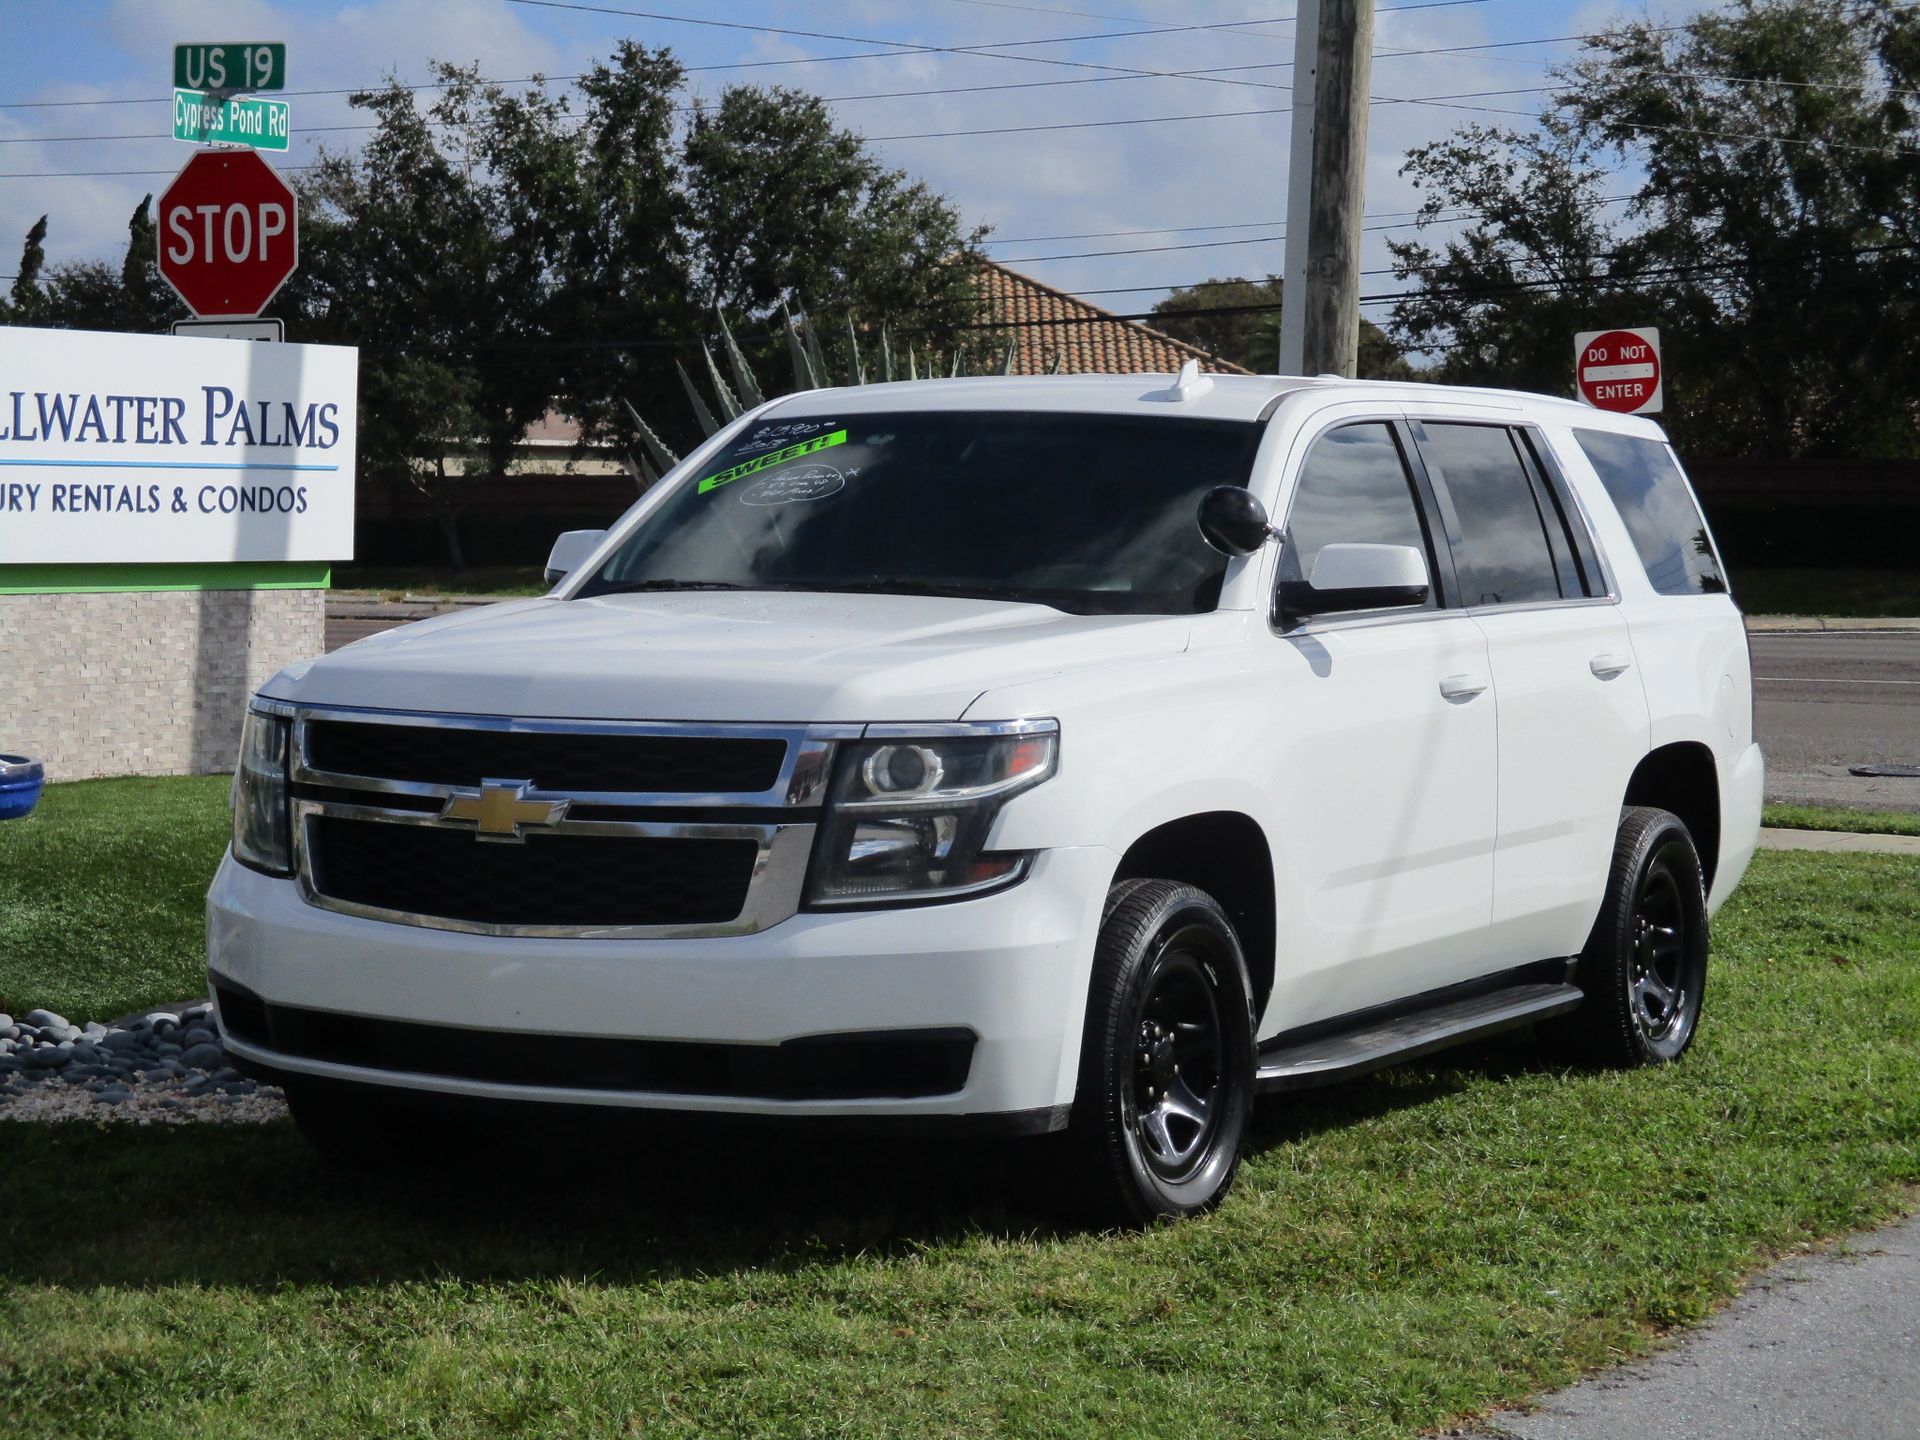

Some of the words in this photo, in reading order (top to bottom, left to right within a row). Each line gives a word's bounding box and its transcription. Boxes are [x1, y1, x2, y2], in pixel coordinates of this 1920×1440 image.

[186, 47, 226, 88] US
[243, 46, 273, 87] 19
[175, 95, 224, 137] Cypress
[230, 101, 262, 134] Pond
[269, 105, 286, 137] Rd
[168, 202, 286, 265] STOP
[1588, 348, 1608, 362] DO
[1620, 345, 1647, 359] NOT
[1595, 383, 1644, 400] ENTER
[200, 385, 340, 450] PALMS
[711, 435, 831, 486] SWEET!
[51, 484, 161, 514] RENTALS
[171, 485, 188, 514] &
[197, 485, 308, 515] CONDOS
